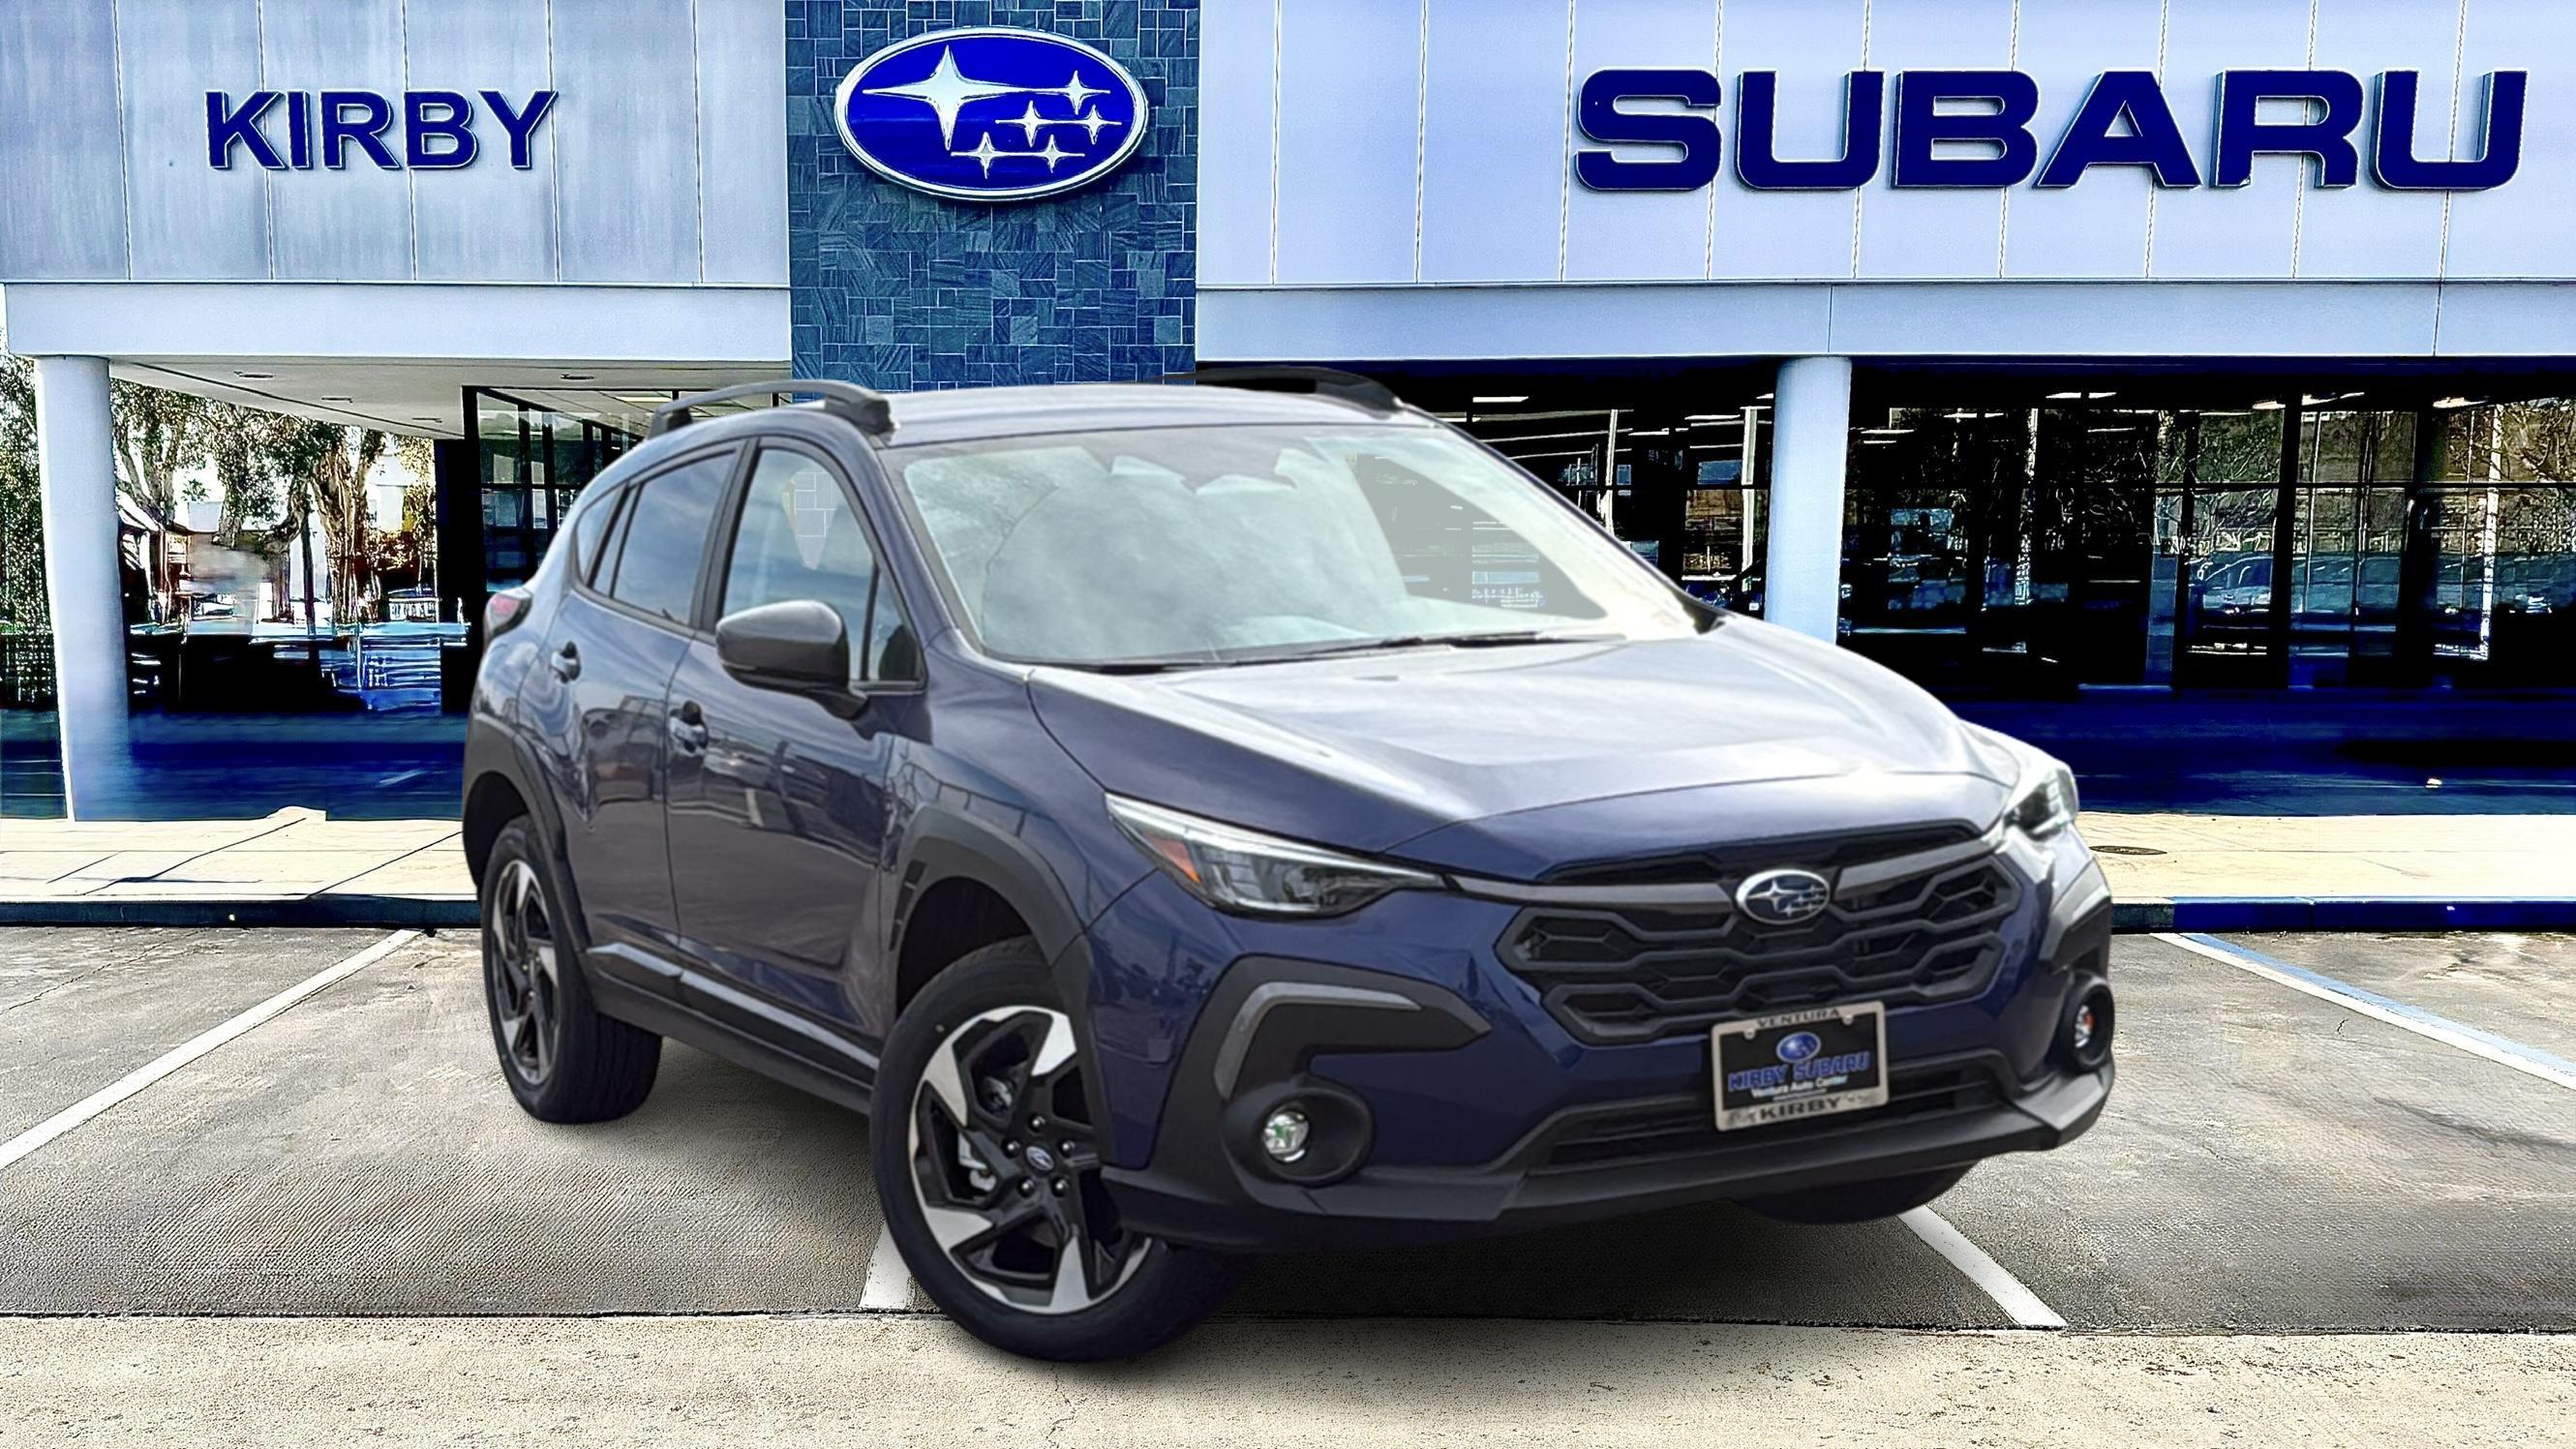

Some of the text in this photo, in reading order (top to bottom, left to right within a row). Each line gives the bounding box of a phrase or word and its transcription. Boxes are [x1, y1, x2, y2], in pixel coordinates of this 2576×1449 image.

[204, 89, 559, 169] KIRBY
[1574, 68, 2528, 191] SUBARU
[1757, 1008, 1840, 1028] VENTURA
[1728, 1051, 1870, 1092] KIRBY SUBARU
[1790, 1080, 1814, 1092] Auto
[1759, 1097, 1841, 1120] KIRBY
